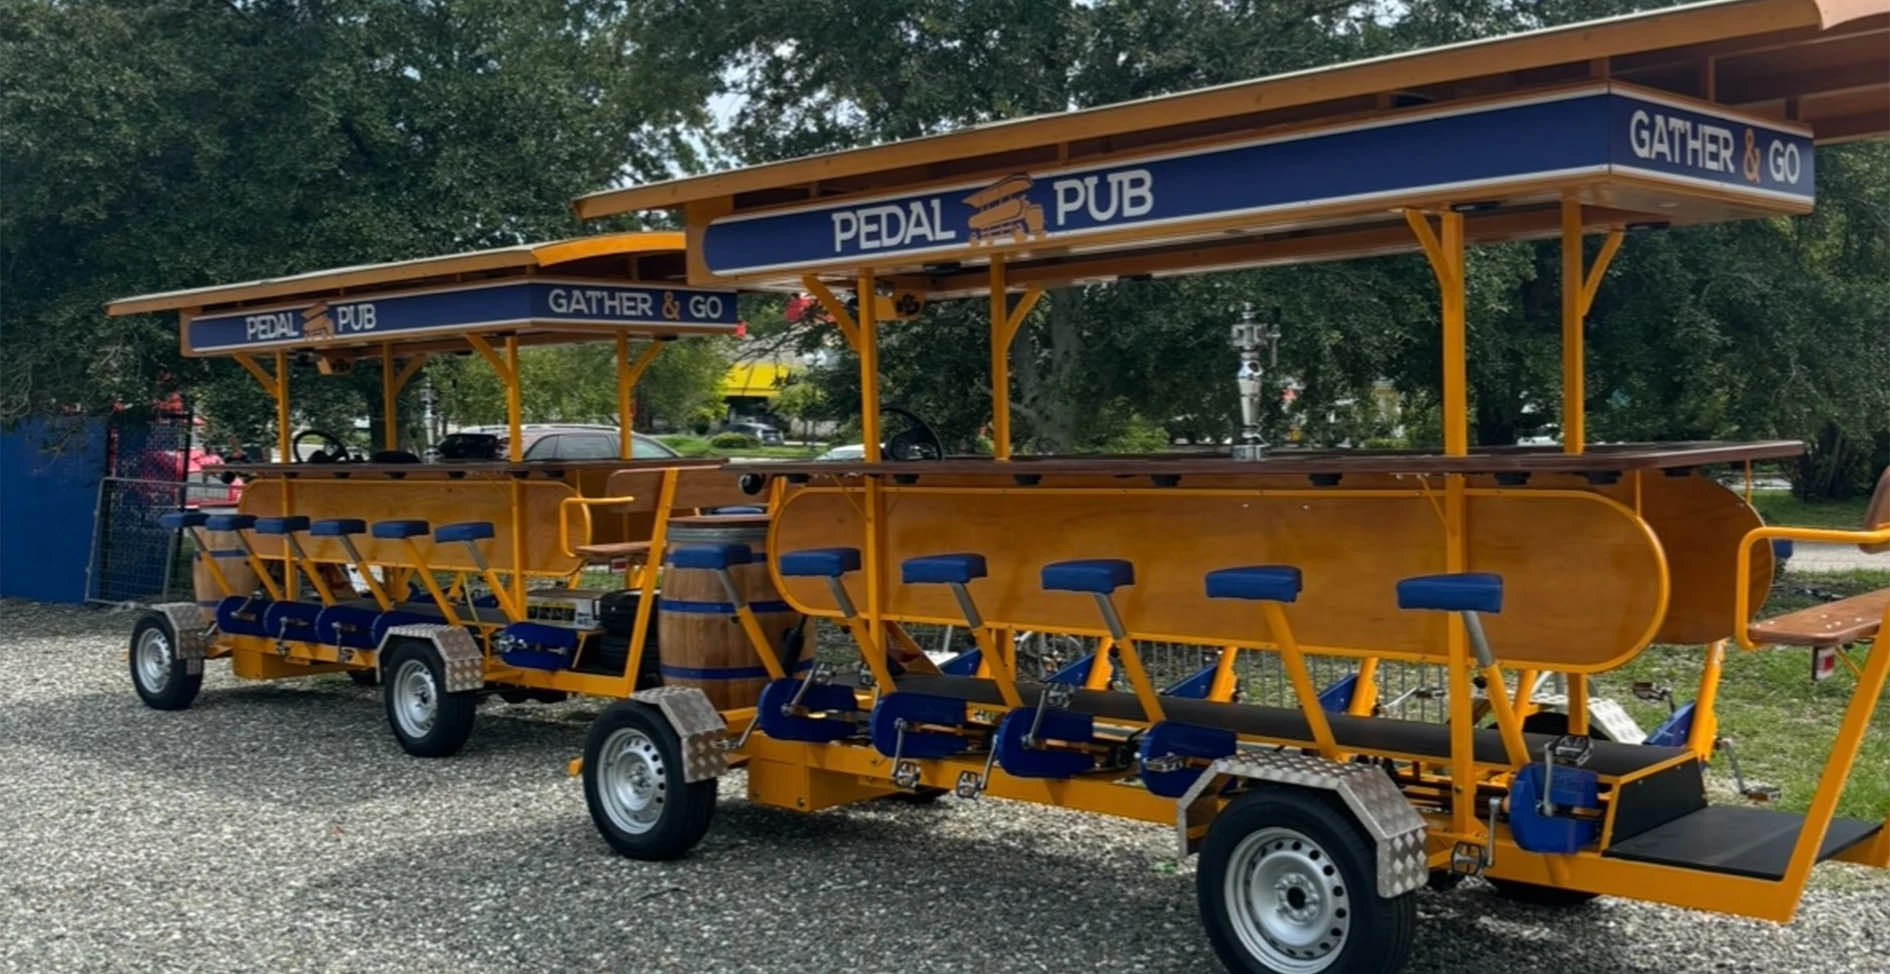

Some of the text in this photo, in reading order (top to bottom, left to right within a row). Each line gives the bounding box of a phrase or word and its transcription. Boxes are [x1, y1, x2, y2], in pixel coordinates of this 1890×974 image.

[1630, 109, 1800, 184] GATHER & GO
[831, 169, 1155, 252] PEDAL PUB
[246, 304, 376, 341] PEDAL PUB
[547, 289, 723, 320] GATHER & GO
